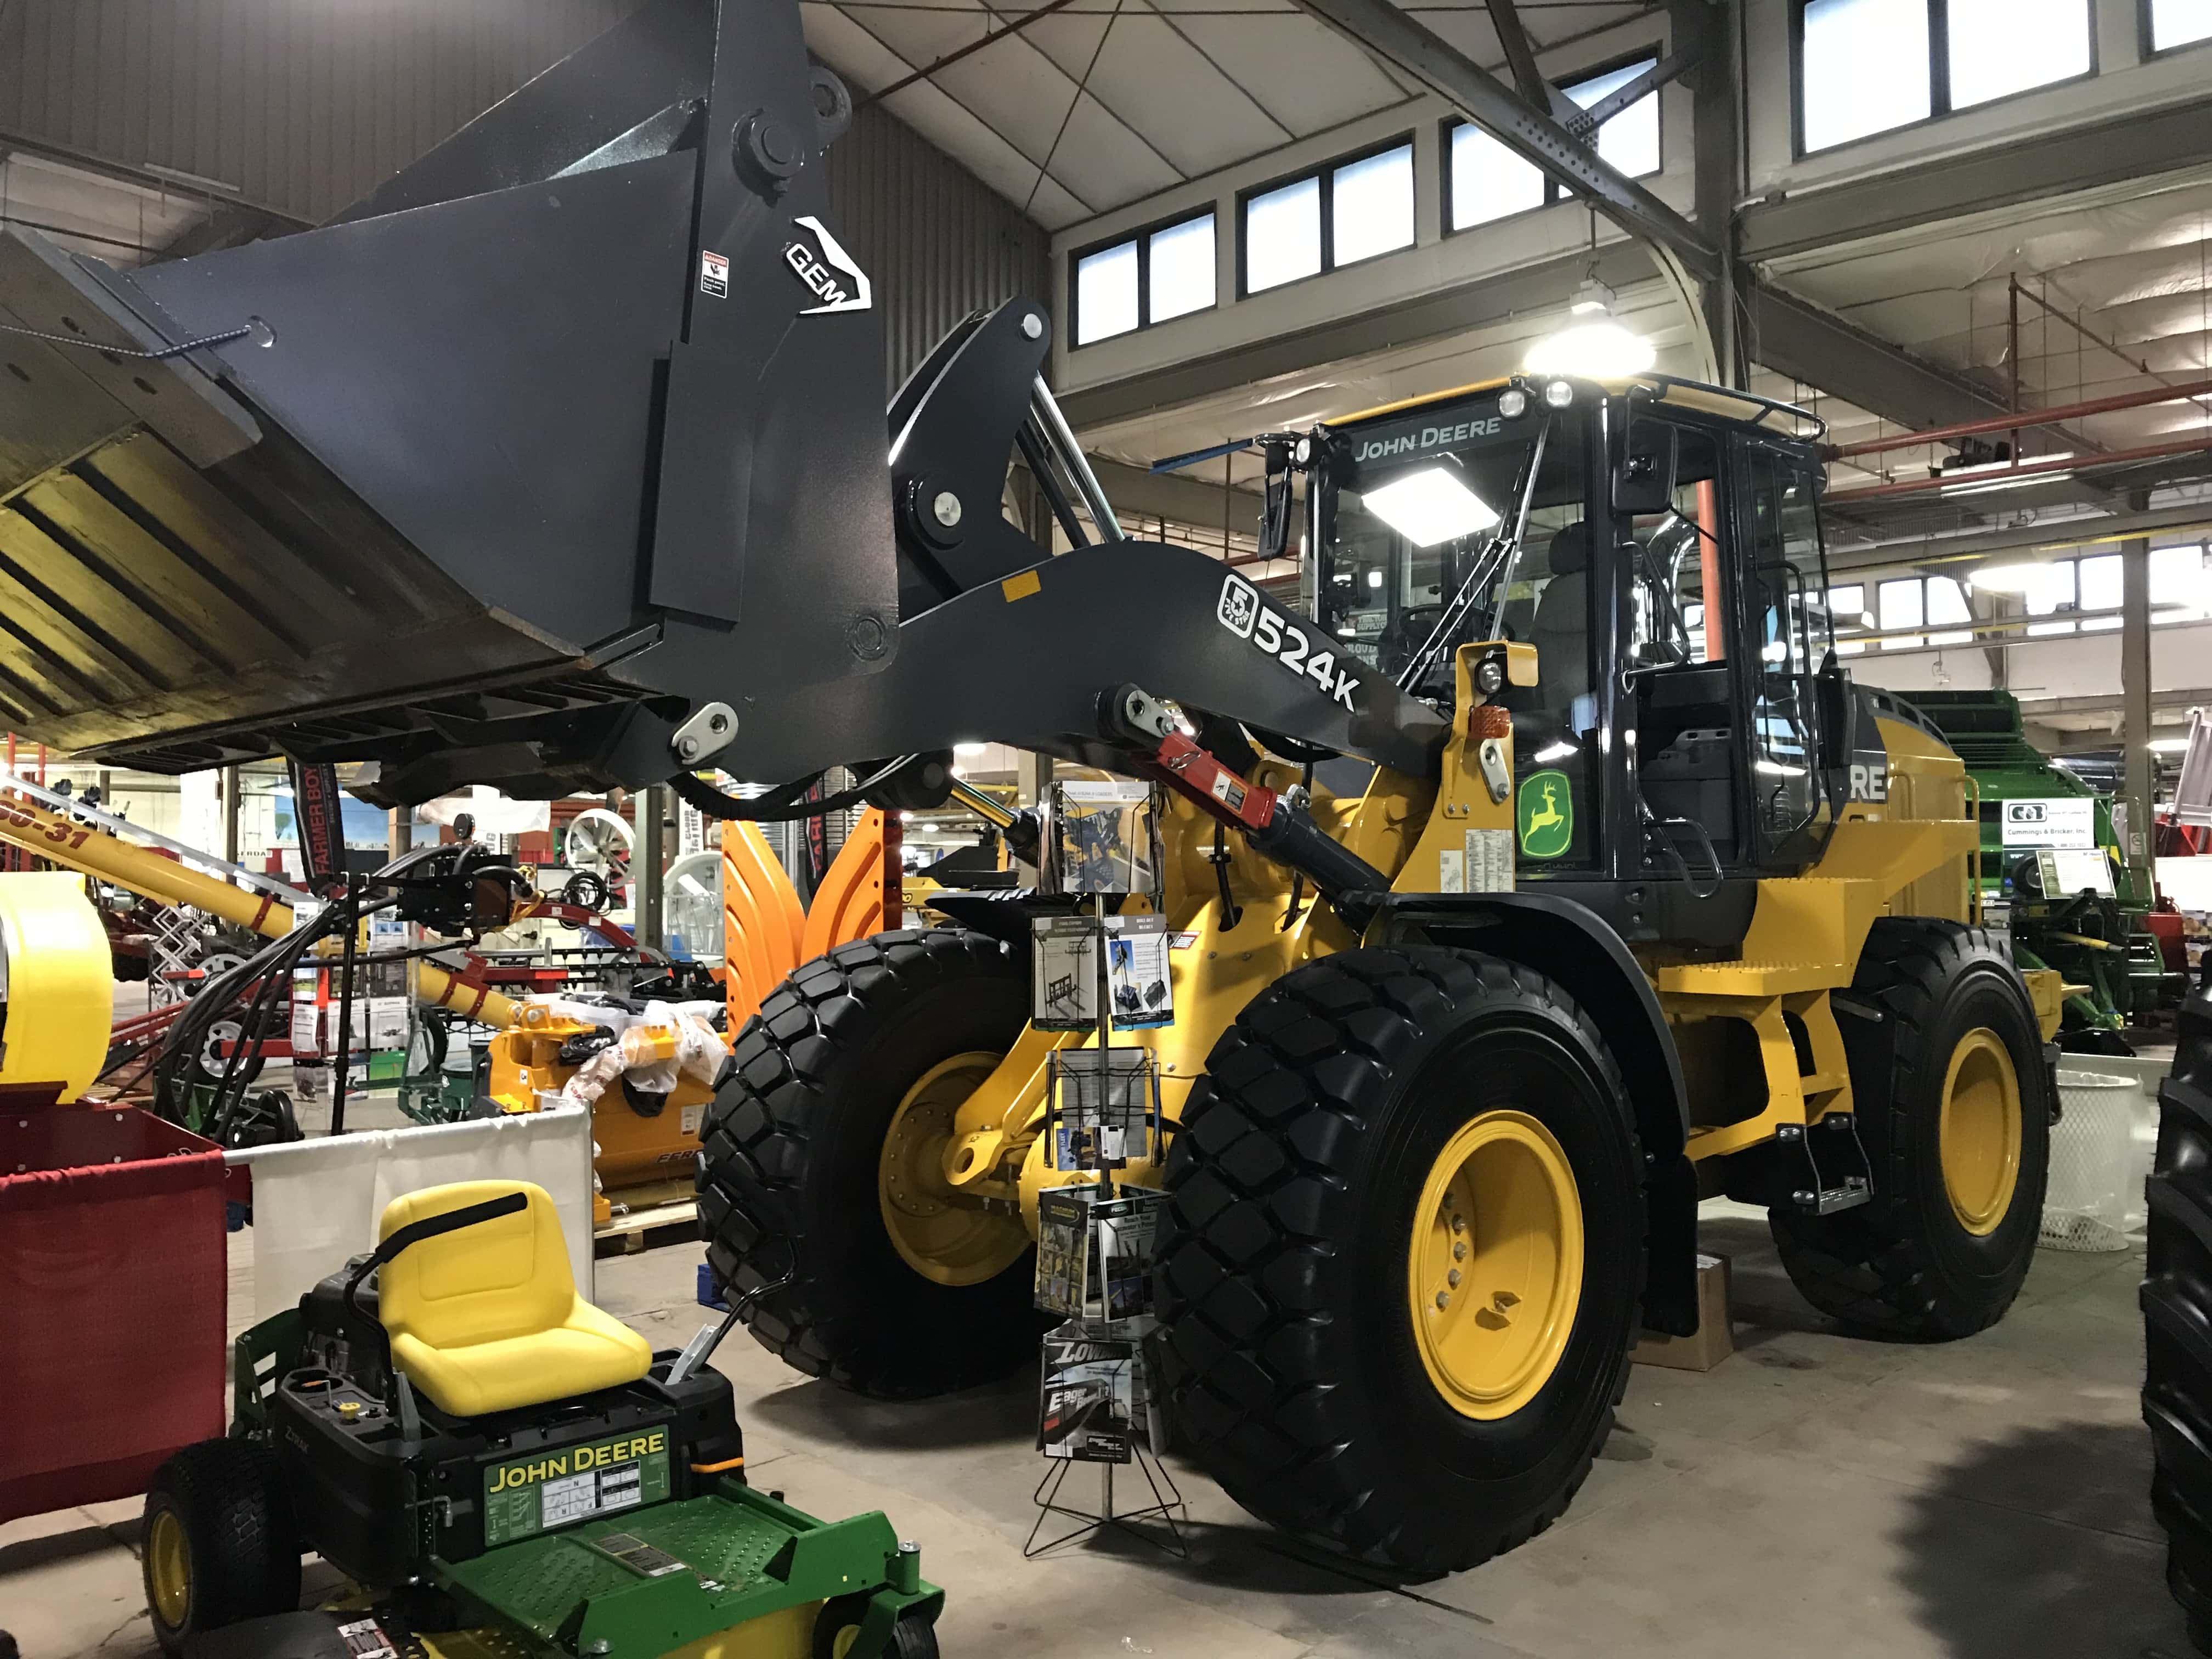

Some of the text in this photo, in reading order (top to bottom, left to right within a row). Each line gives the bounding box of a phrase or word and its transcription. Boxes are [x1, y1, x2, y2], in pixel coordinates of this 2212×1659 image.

[786, 243, 847, 307] GEM
[1355, 417, 1502, 462] JOHN DEERE
[1234, 610, 1250, 625] STAR
[1254, 606, 1361, 713] 524K
[303, 766, 323, 800] BOY
[1850, 764, 1886, 800] RE
[308, 803, 330, 874] FARMER
[489, 1432, 664, 1493] JOHN DEERE
